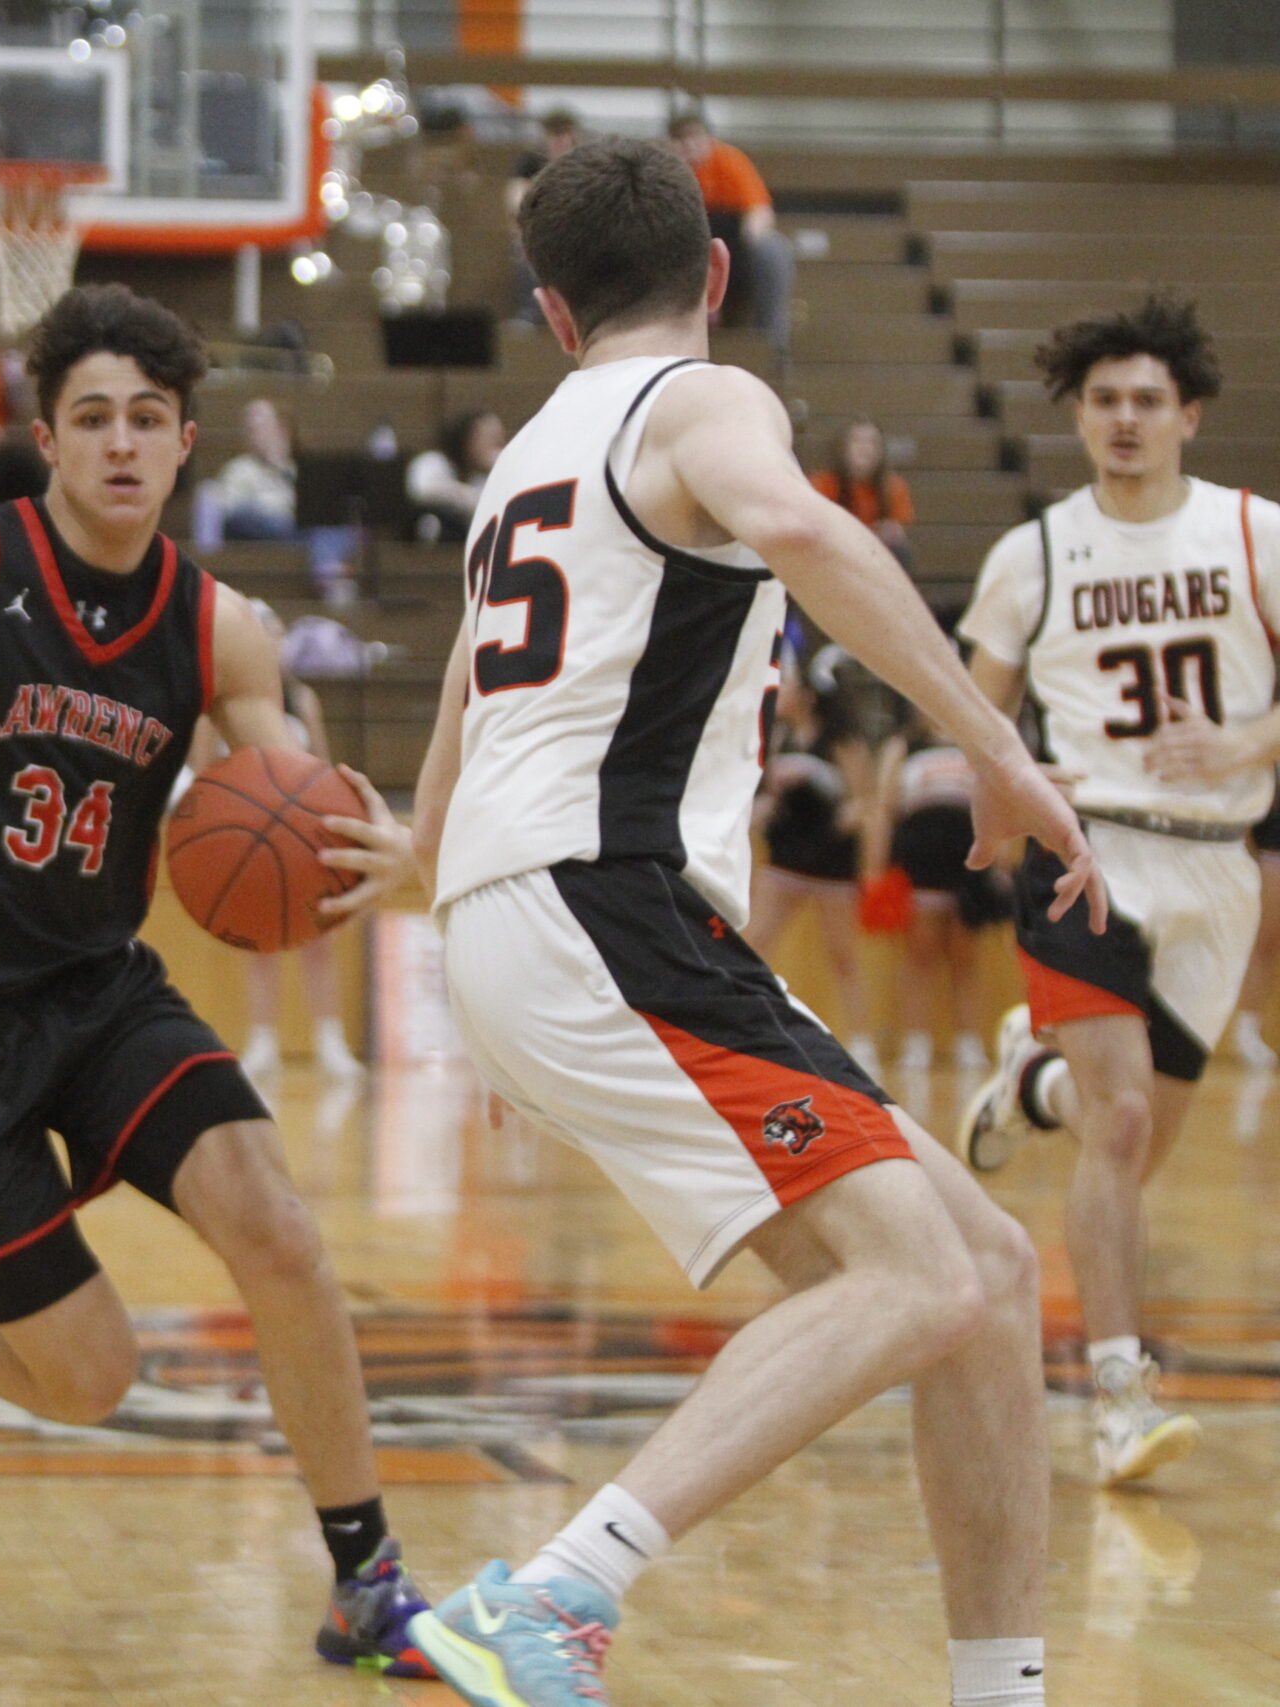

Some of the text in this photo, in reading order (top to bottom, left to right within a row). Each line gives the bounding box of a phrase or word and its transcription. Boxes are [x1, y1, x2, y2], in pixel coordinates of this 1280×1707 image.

[1072, 566, 1231, 632] COUGARS
[1098, 635, 1224, 739] 30
[3, 764, 115, 876] 34
